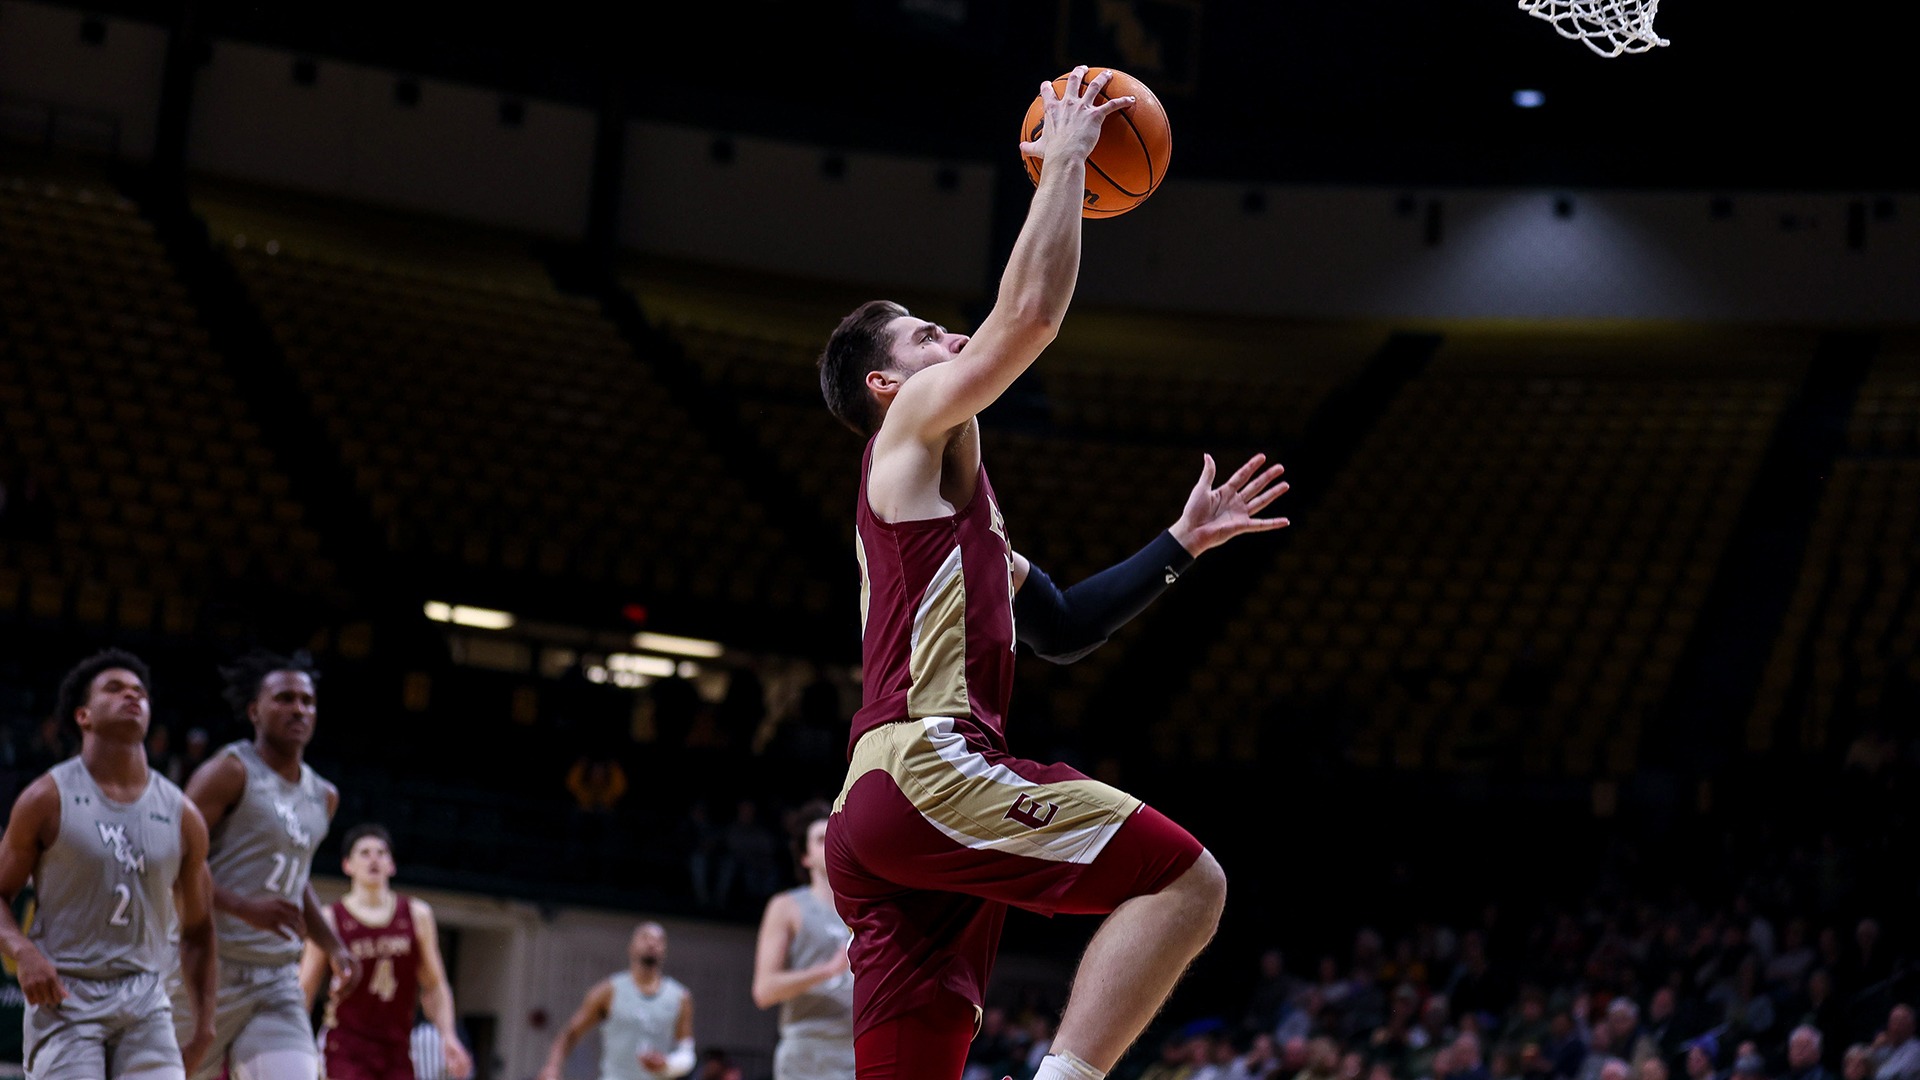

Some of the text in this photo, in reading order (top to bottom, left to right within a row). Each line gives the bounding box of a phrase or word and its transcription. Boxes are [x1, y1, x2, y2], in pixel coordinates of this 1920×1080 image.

[1002, 791, 1060, 831] E
[264, 852, 300, 895] 21
[109, 882, 132, 926] 2
[368, 957, 399, 1002] 4
